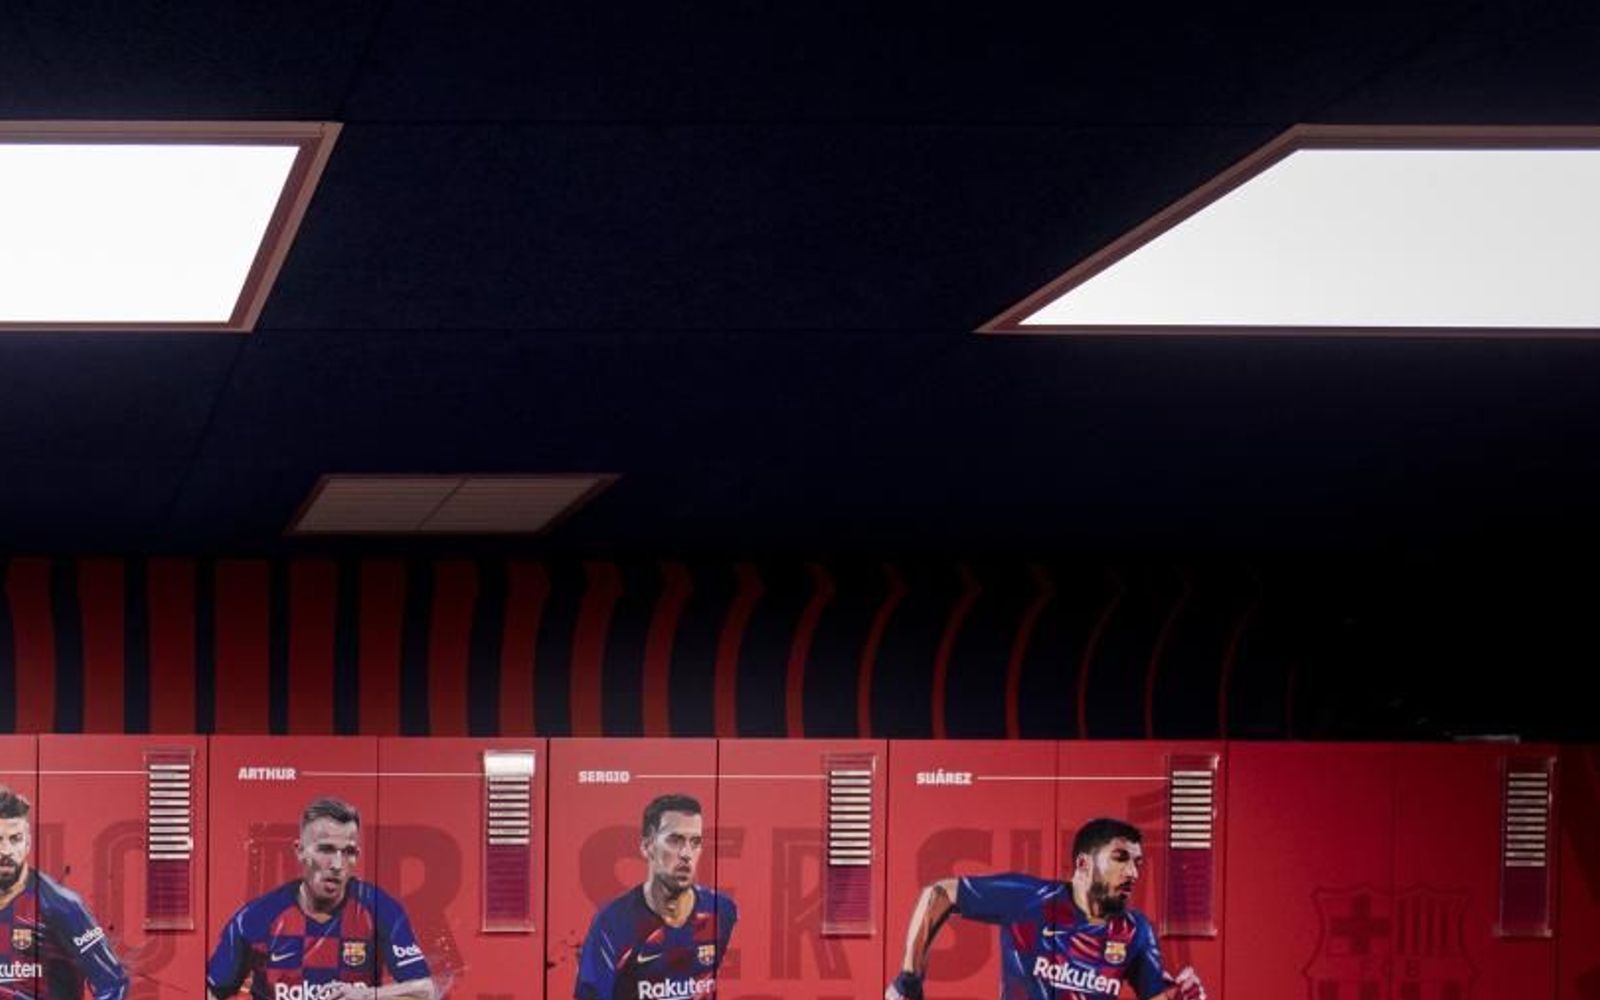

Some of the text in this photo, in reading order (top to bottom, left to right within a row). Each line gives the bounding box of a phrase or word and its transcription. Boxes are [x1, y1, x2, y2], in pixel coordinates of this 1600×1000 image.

[238, 767, 296, 779] ARTHUR
[578, 771, 630, 783] SERGIO
[916, 769, 972, 784] SUÁREZ
[1032, 956, 1121, 996] Rakuten
[637, 977, 715, 1000] Rakuten
